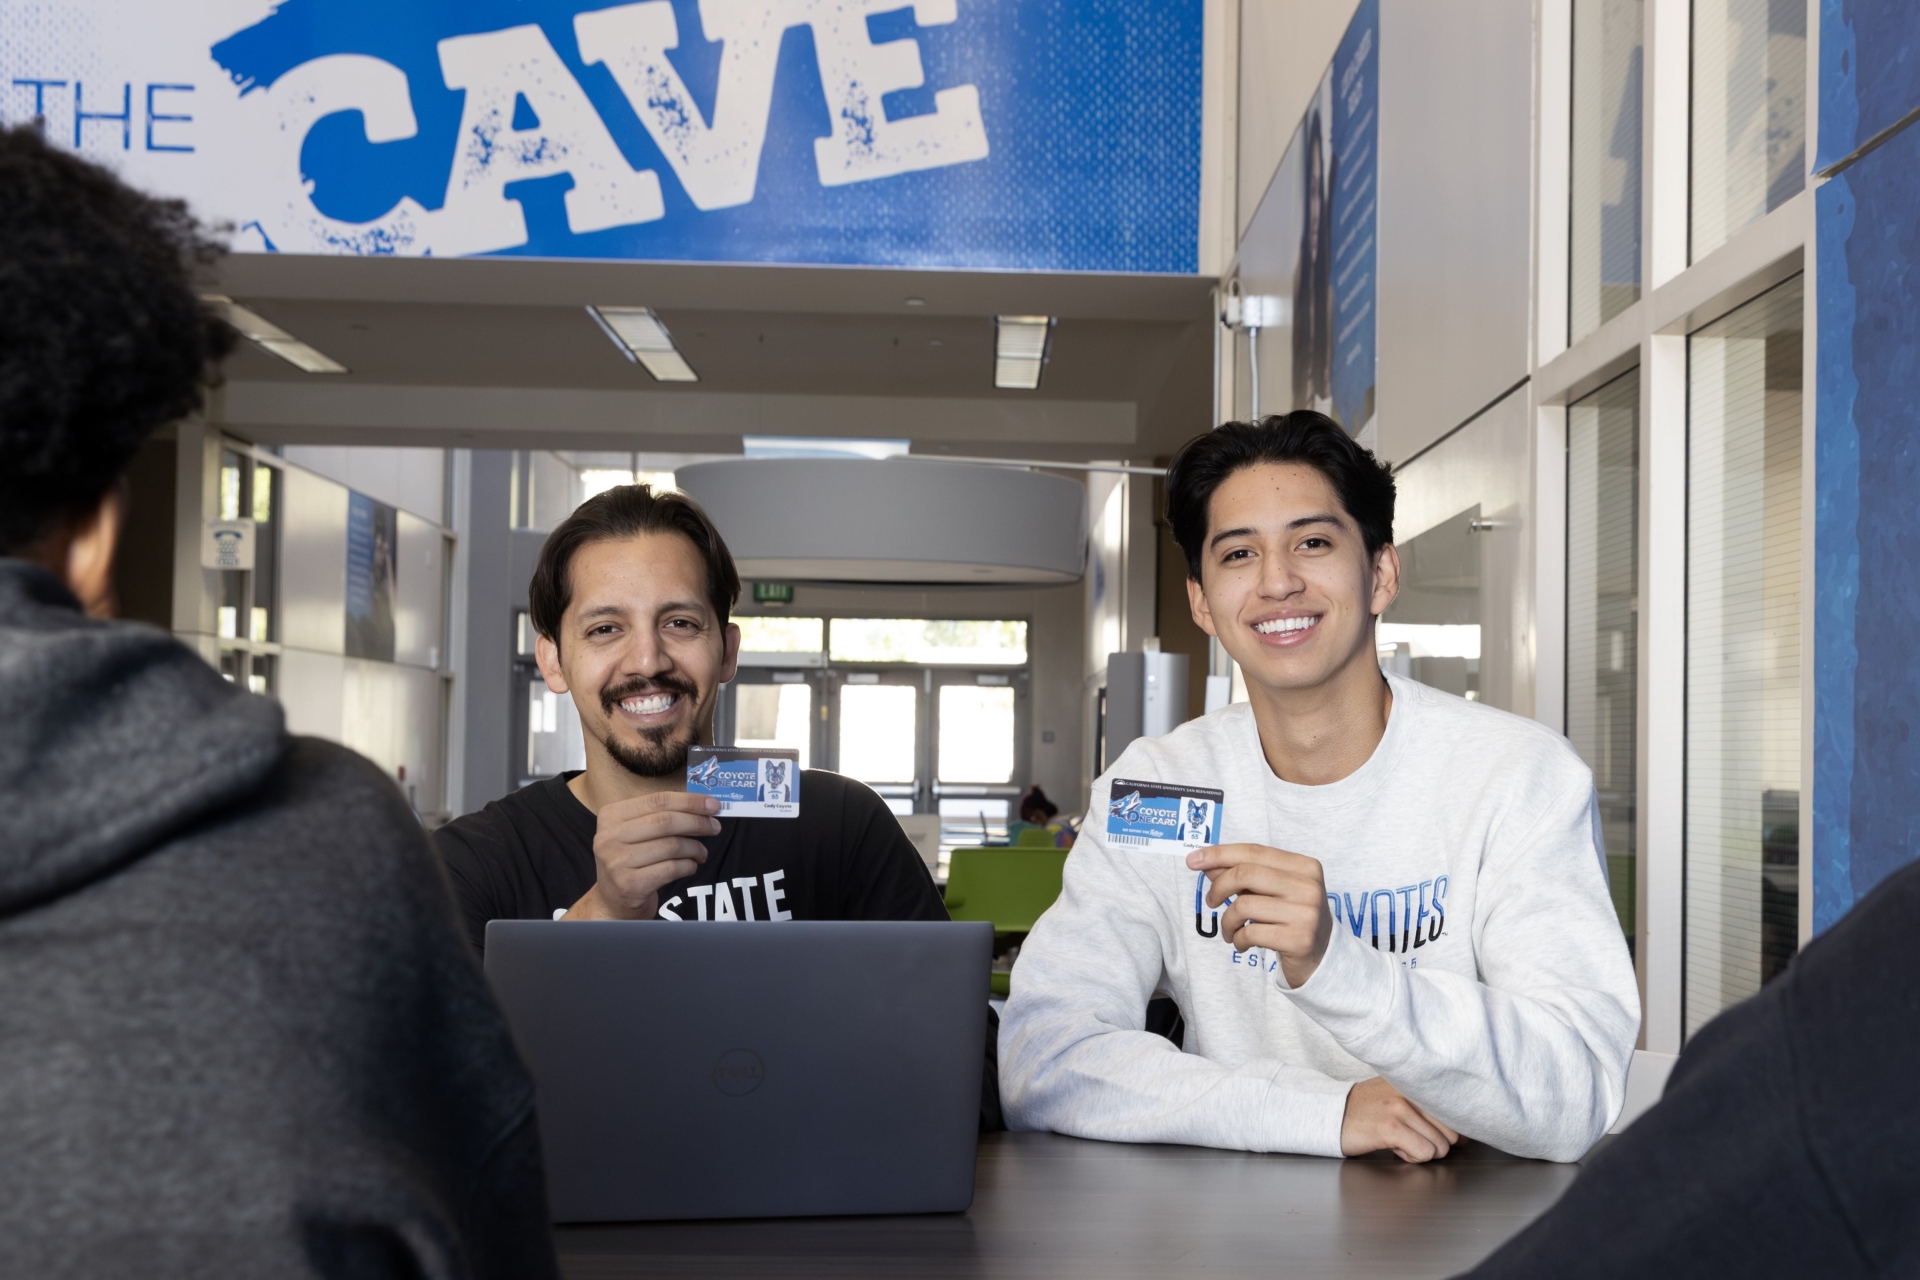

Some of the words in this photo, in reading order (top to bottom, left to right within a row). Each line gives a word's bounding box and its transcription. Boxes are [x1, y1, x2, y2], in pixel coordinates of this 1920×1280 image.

[12, 79, 195, 153] THE
[255, 0, 989, 257] CAVE
[718, 772, 756, 780] COYOTE
[1196, 788, 1222, 796] BERNARDINO
[1139, 807, 1177, 818] COYOTE
